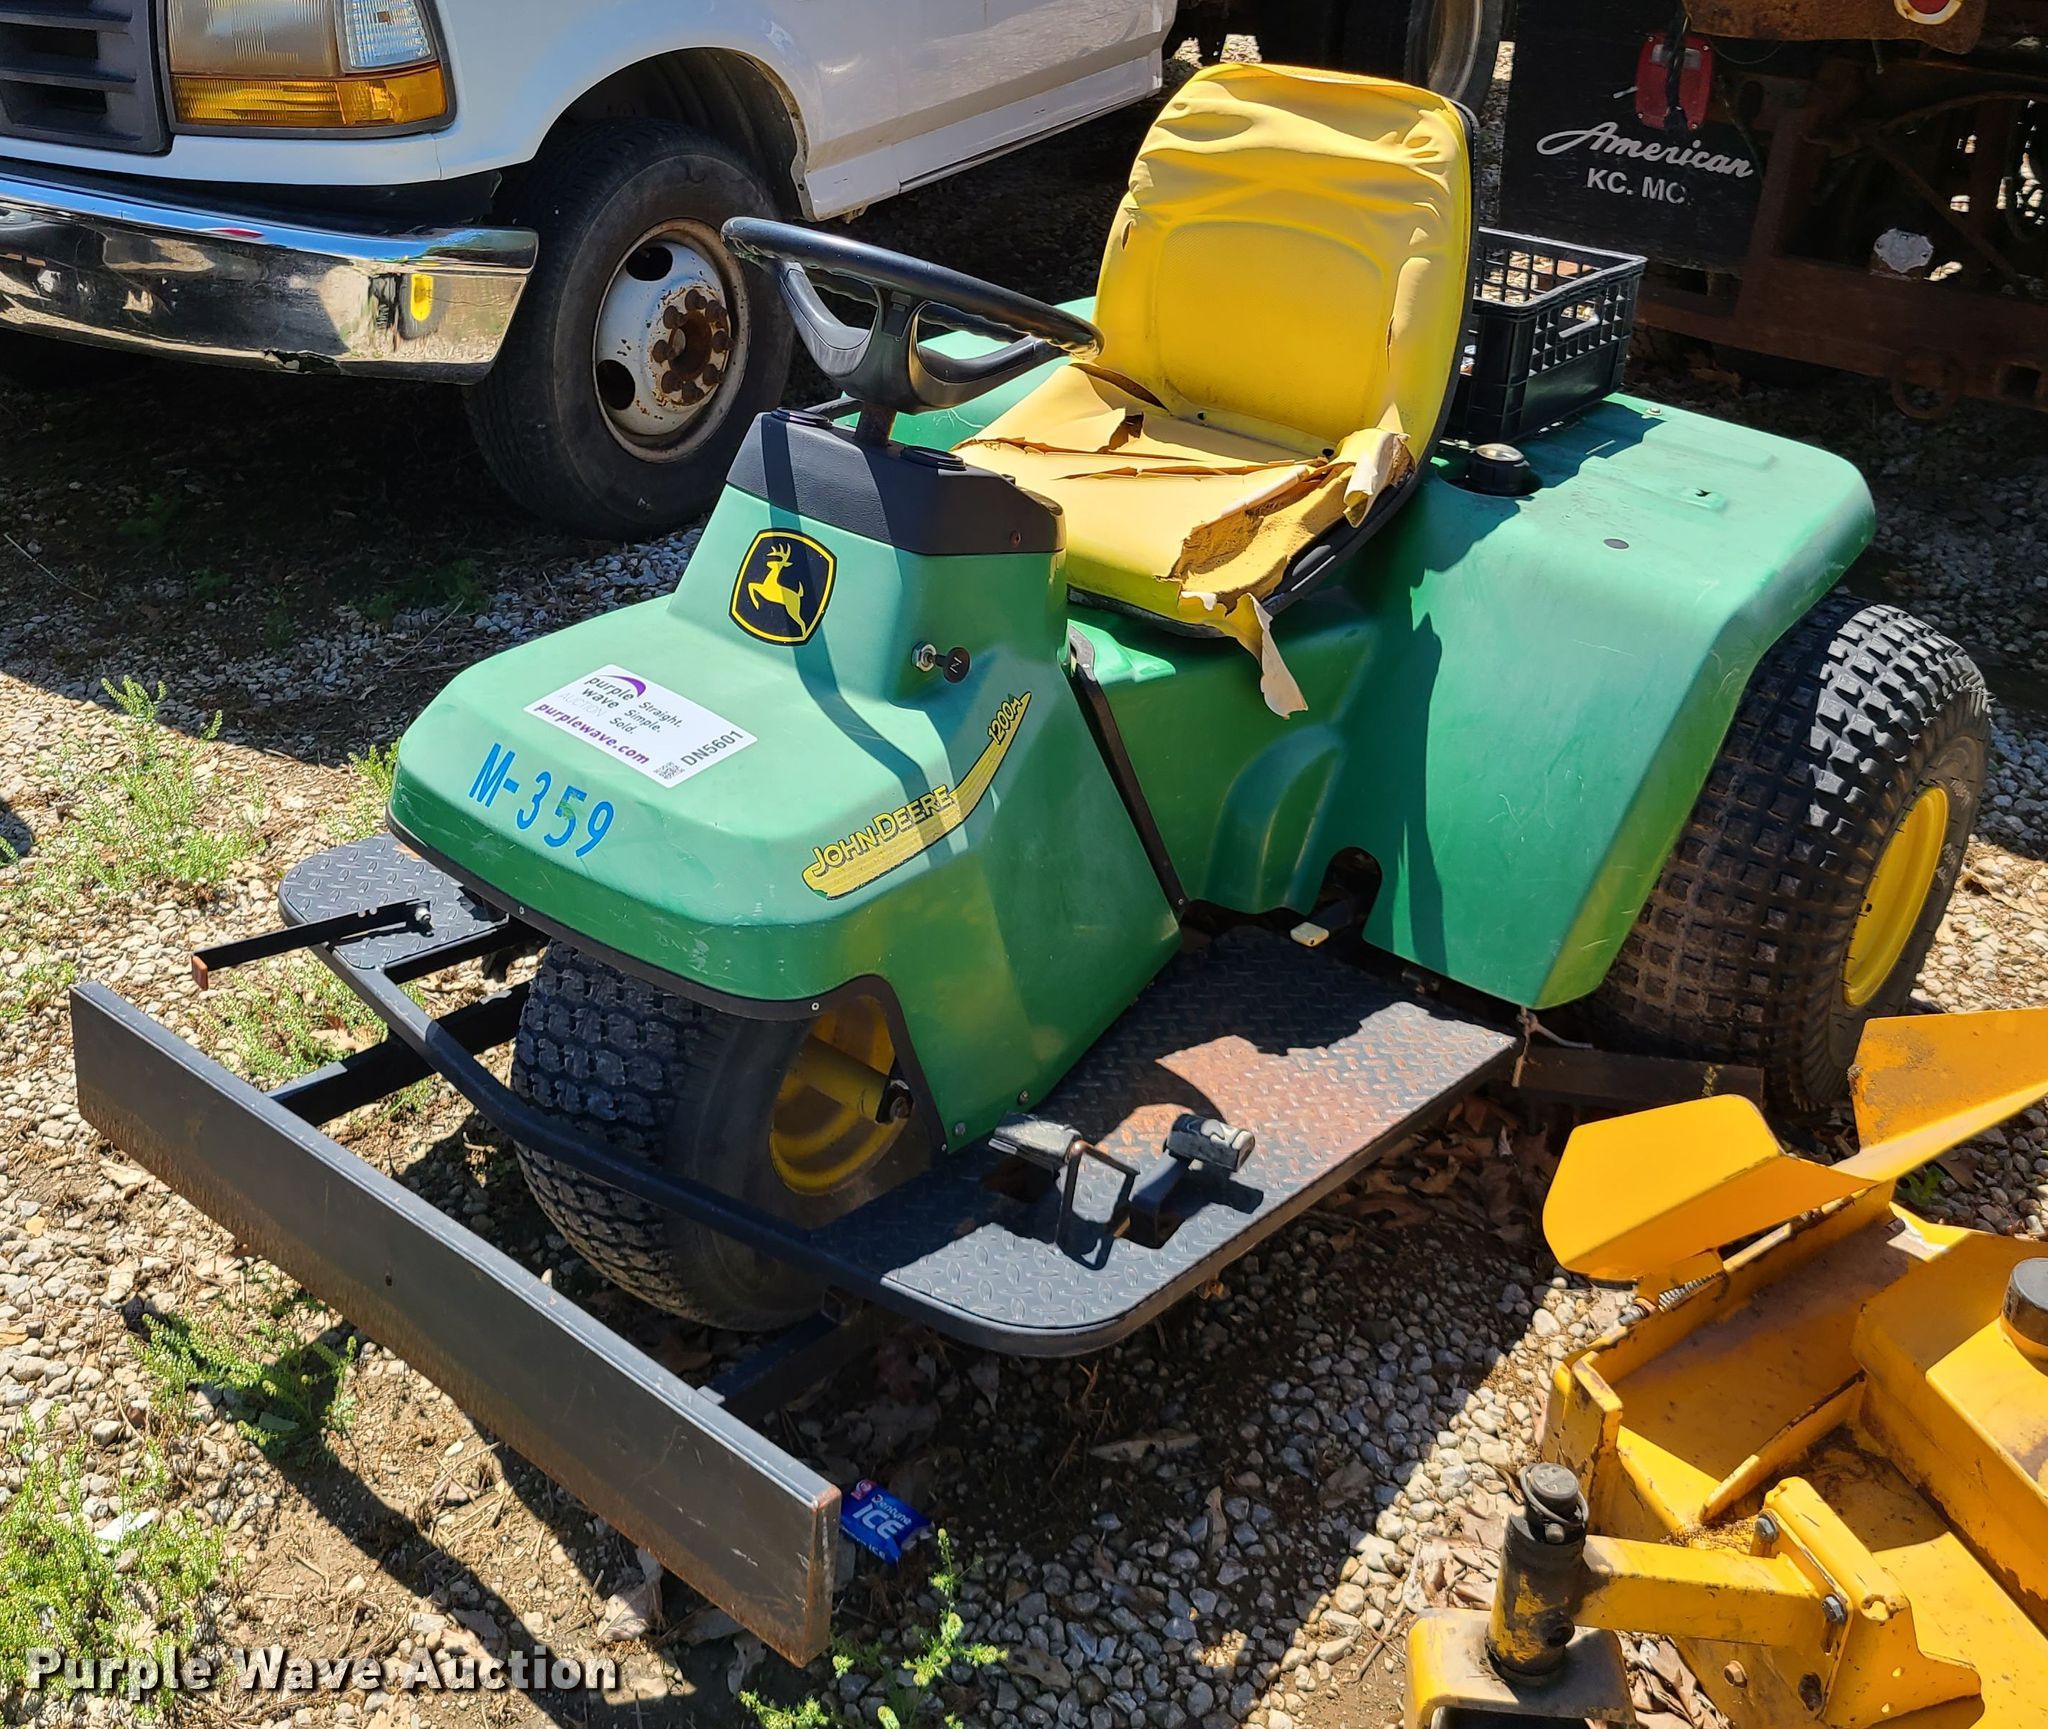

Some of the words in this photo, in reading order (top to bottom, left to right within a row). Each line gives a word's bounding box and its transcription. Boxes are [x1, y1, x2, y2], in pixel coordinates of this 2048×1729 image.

[1536, 121, 1754, 178] American
[1586, 167, 1634, 195] KC.
[582, 688, 619, 709] wave
[584, 677, 634, 700] purple
[609, 717, 638, 735] Sold.
[624, 709, 661, 733] Simple.
[639, 701, 683, 728] Straight.
[534, 703, 650, 765] purplewave.com
[680, 730, 743, 766] DN5601
[468, 743, 615, 858] M-359
[811, 825, 877, 878] JOHN
[872, 784, 952, 842] DEERE
[852, 1502, 905, 1540] ICE
